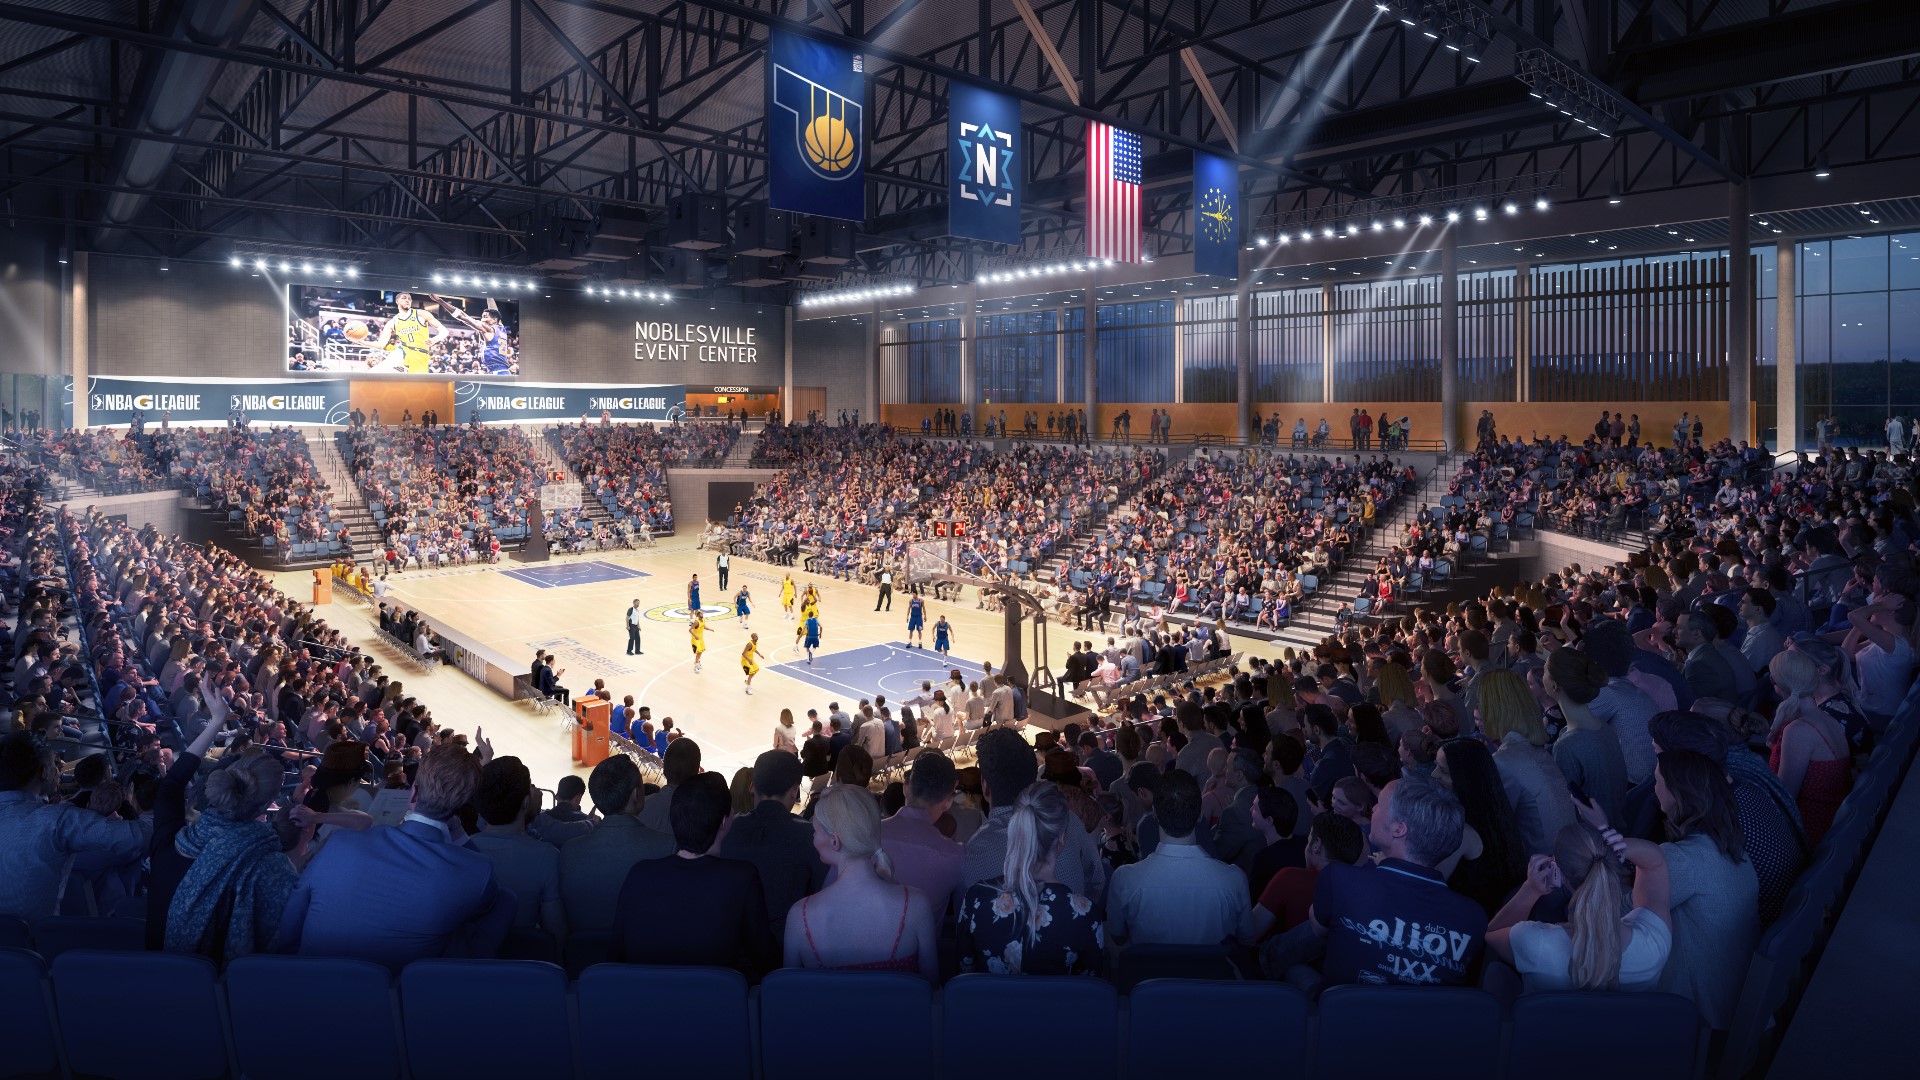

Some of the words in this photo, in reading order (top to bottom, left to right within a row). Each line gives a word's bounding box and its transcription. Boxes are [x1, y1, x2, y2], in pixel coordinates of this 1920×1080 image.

[976, 142, 997, 187] N
[635, 321, 756, 345] NOBLESVILLE
[634, 342, 690, 361] EVENT
[699, 345, 757, 363] CENTER
[106, 395, 133, 410] NBA
[134, 395, 153, 410] G
[155, 395, 200, 410] LEAGUE
[242, 395, 267, 410] NBA
[267, 396, 284, 410] G
[286, 396, 325, 410] LEAGUE
[488, 397, 511, 409] NBA
[510, 397, 527, 409] G
[528, 397, 565, 409] LEAGUE
[599, 398, 618, 410] NBA
[619, 398, 632, 409] G
[634, 398, 666, 409] LEAGUE
[936, 522, 947, 536] 24
[954, 522, 966, 536] 24
